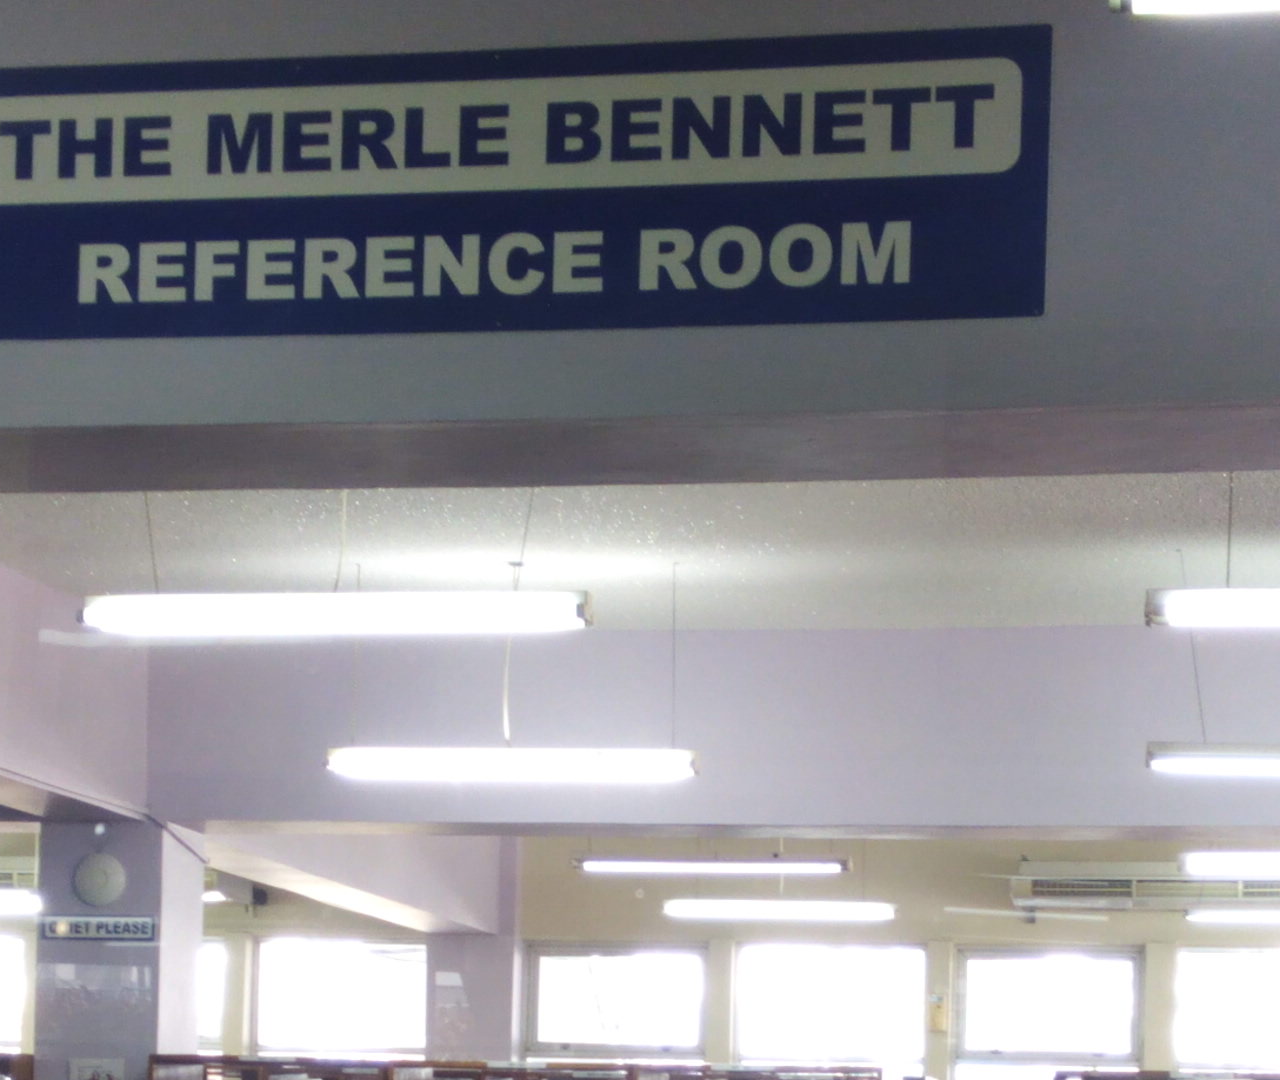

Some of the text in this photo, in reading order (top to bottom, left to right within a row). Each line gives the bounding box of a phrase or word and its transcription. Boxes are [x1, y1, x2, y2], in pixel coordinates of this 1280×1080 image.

[205, 102, 510, 177] MERLE
[543, 83, 995, 165] BENNETT
[76, 220, 913, 305] REFERENCE ROOM
[48, 920, 150, 935] QIET PLEASE
